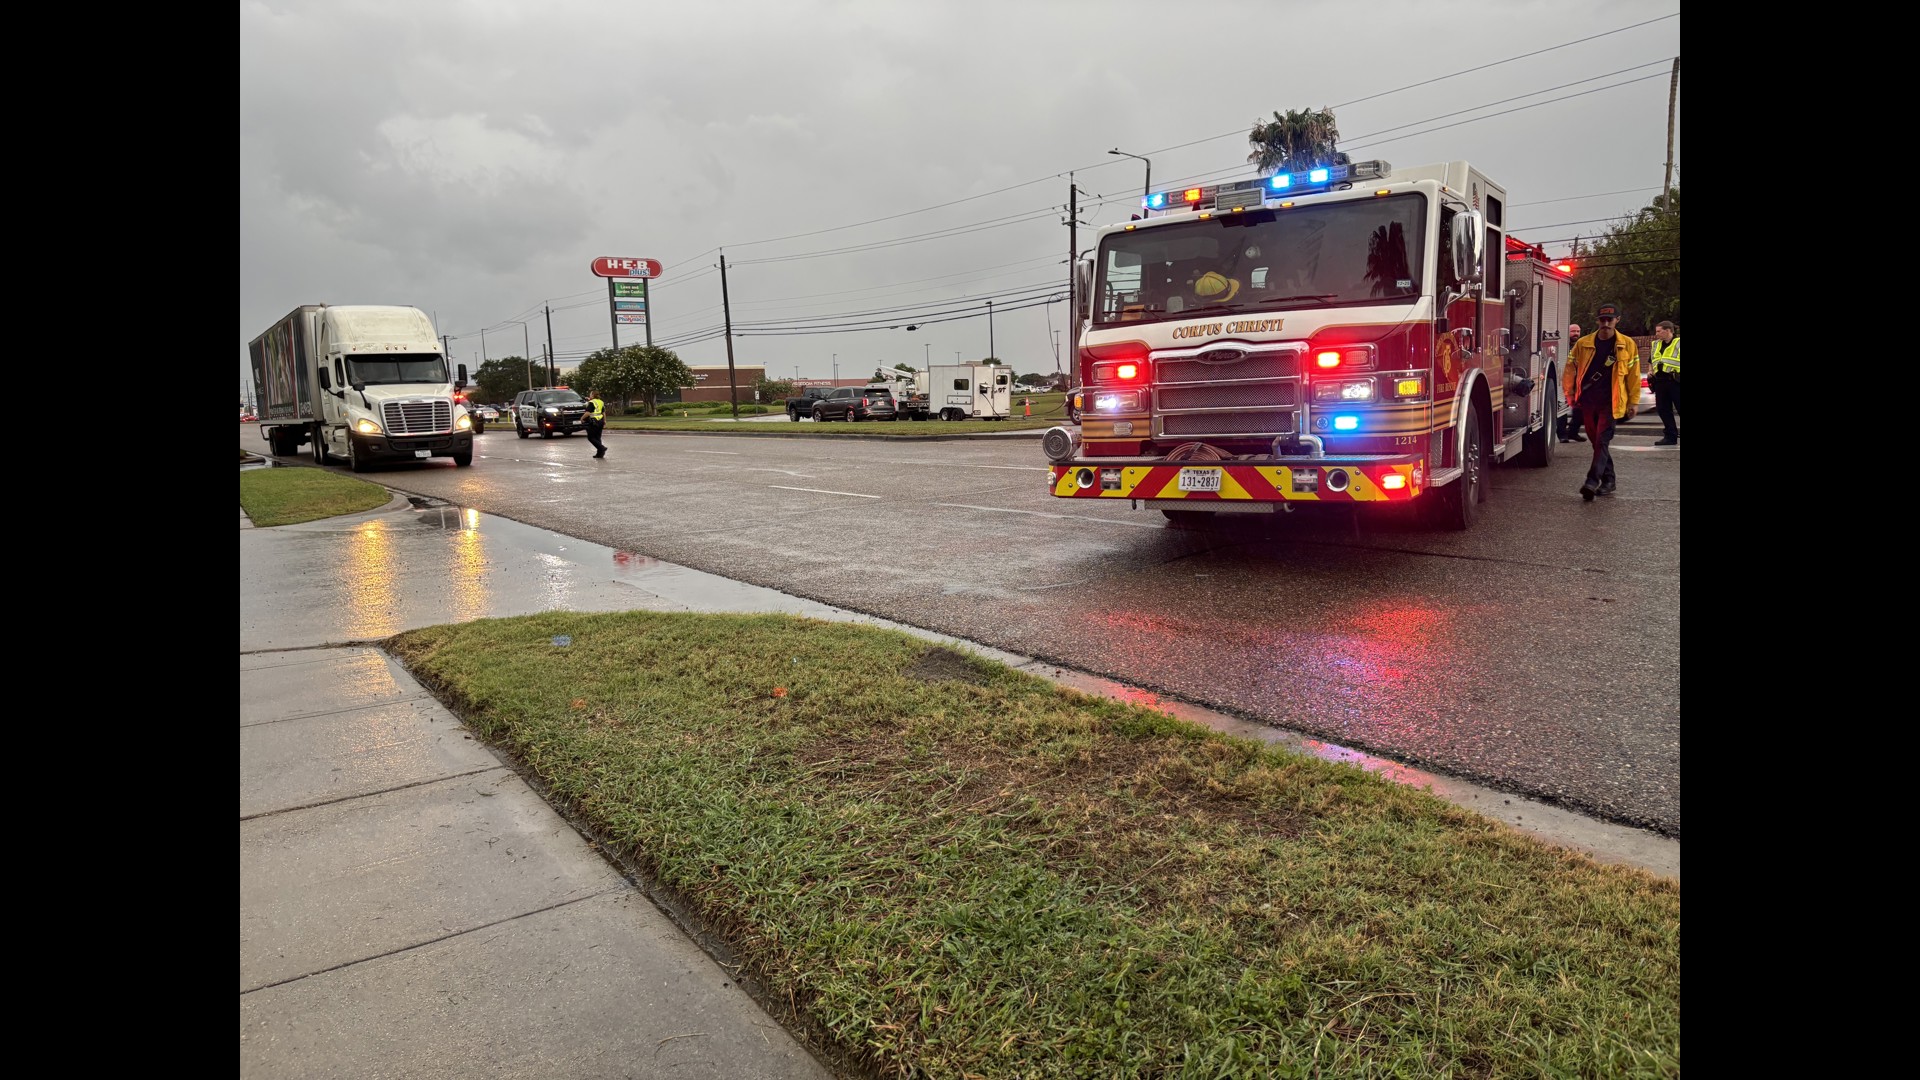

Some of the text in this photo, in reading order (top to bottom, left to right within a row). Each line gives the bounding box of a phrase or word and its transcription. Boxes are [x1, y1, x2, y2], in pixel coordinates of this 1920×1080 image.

[1172, 318, 1284, 340] CORPUS CHRISTI
[1208, 351, 1237, 360] Pierce
[521, 411, 533, 419] POLICE
[1394, 435, 1418, 446] 1214
